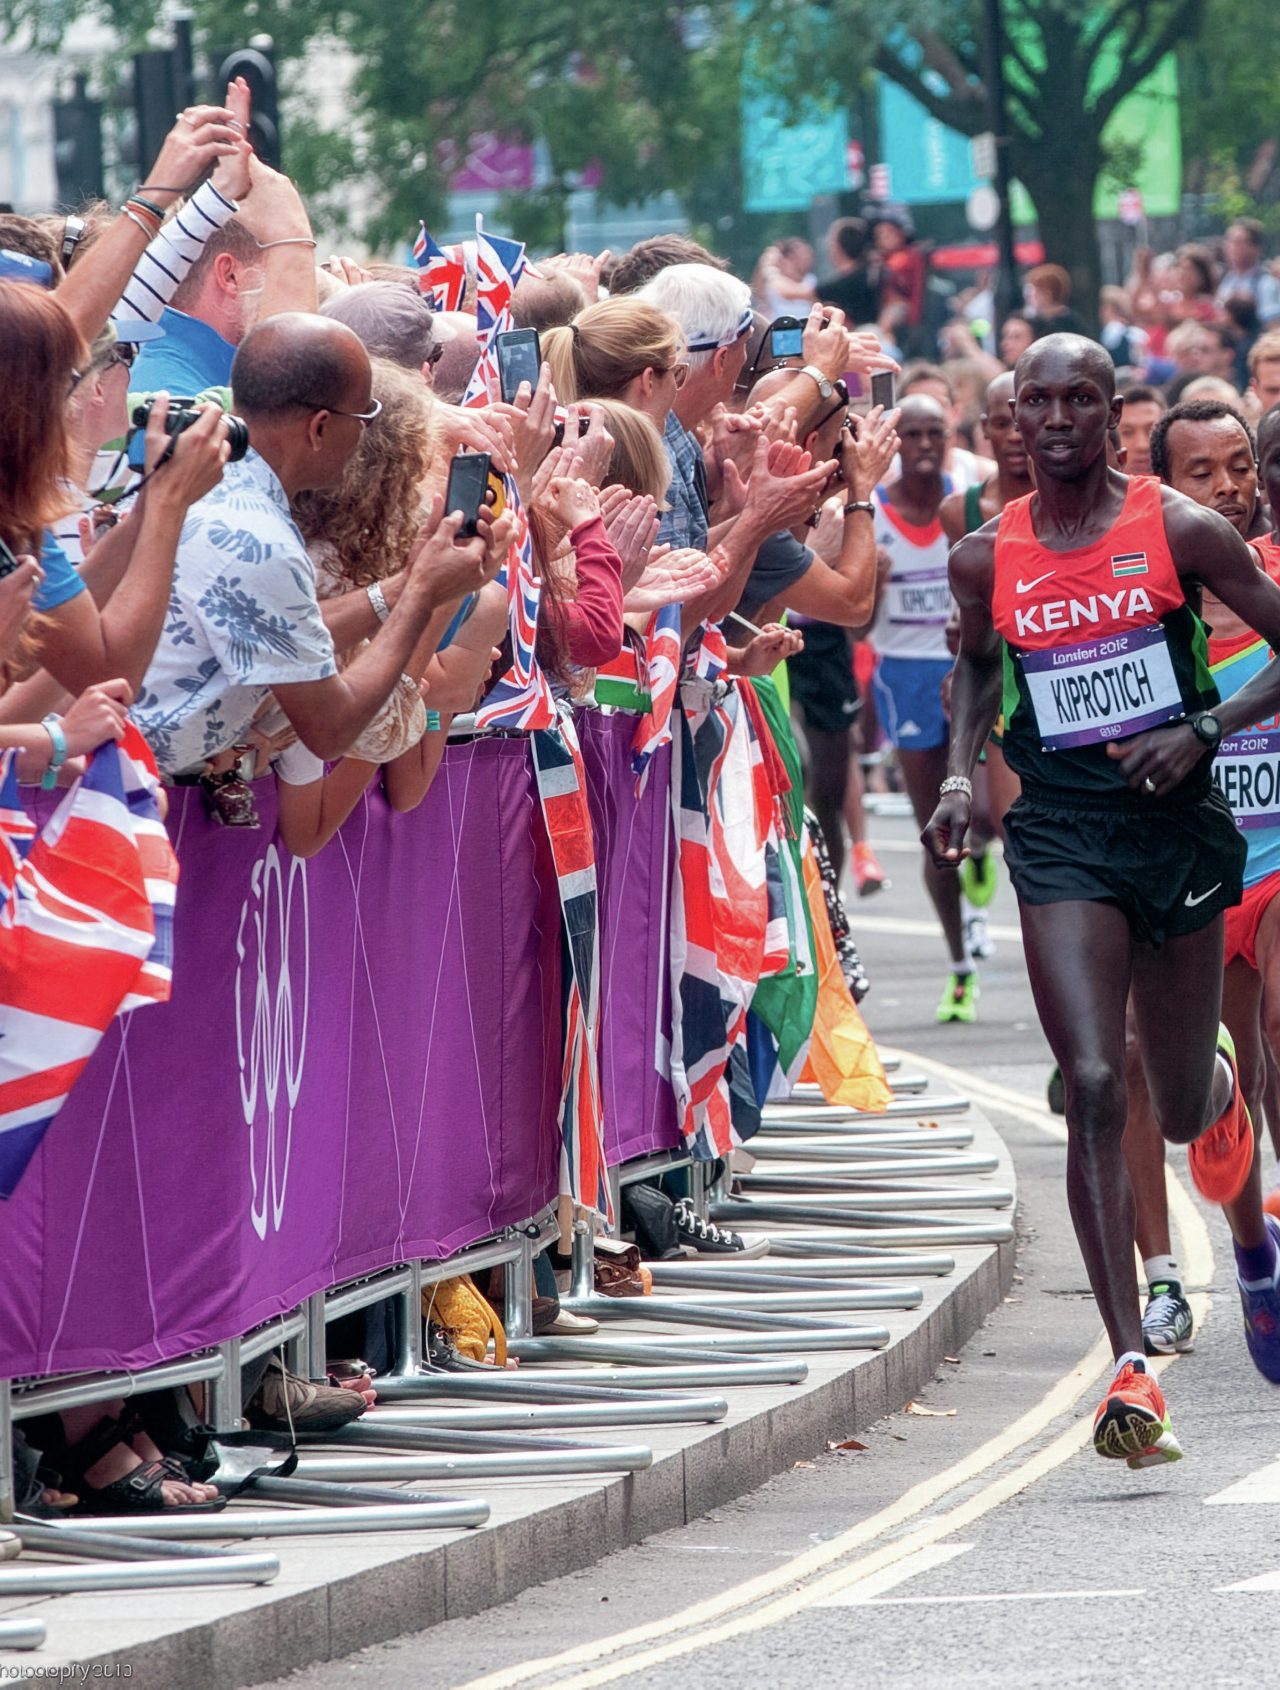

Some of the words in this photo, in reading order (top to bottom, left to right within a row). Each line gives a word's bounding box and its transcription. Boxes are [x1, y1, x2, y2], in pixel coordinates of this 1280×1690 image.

[1014, 587, 1154, 637] KENYA
[1052, 648, 1097, 666] London
[1099, 638, 1129, 656] 2012
[1050, 658, 1155, 725] KIPROTICH
